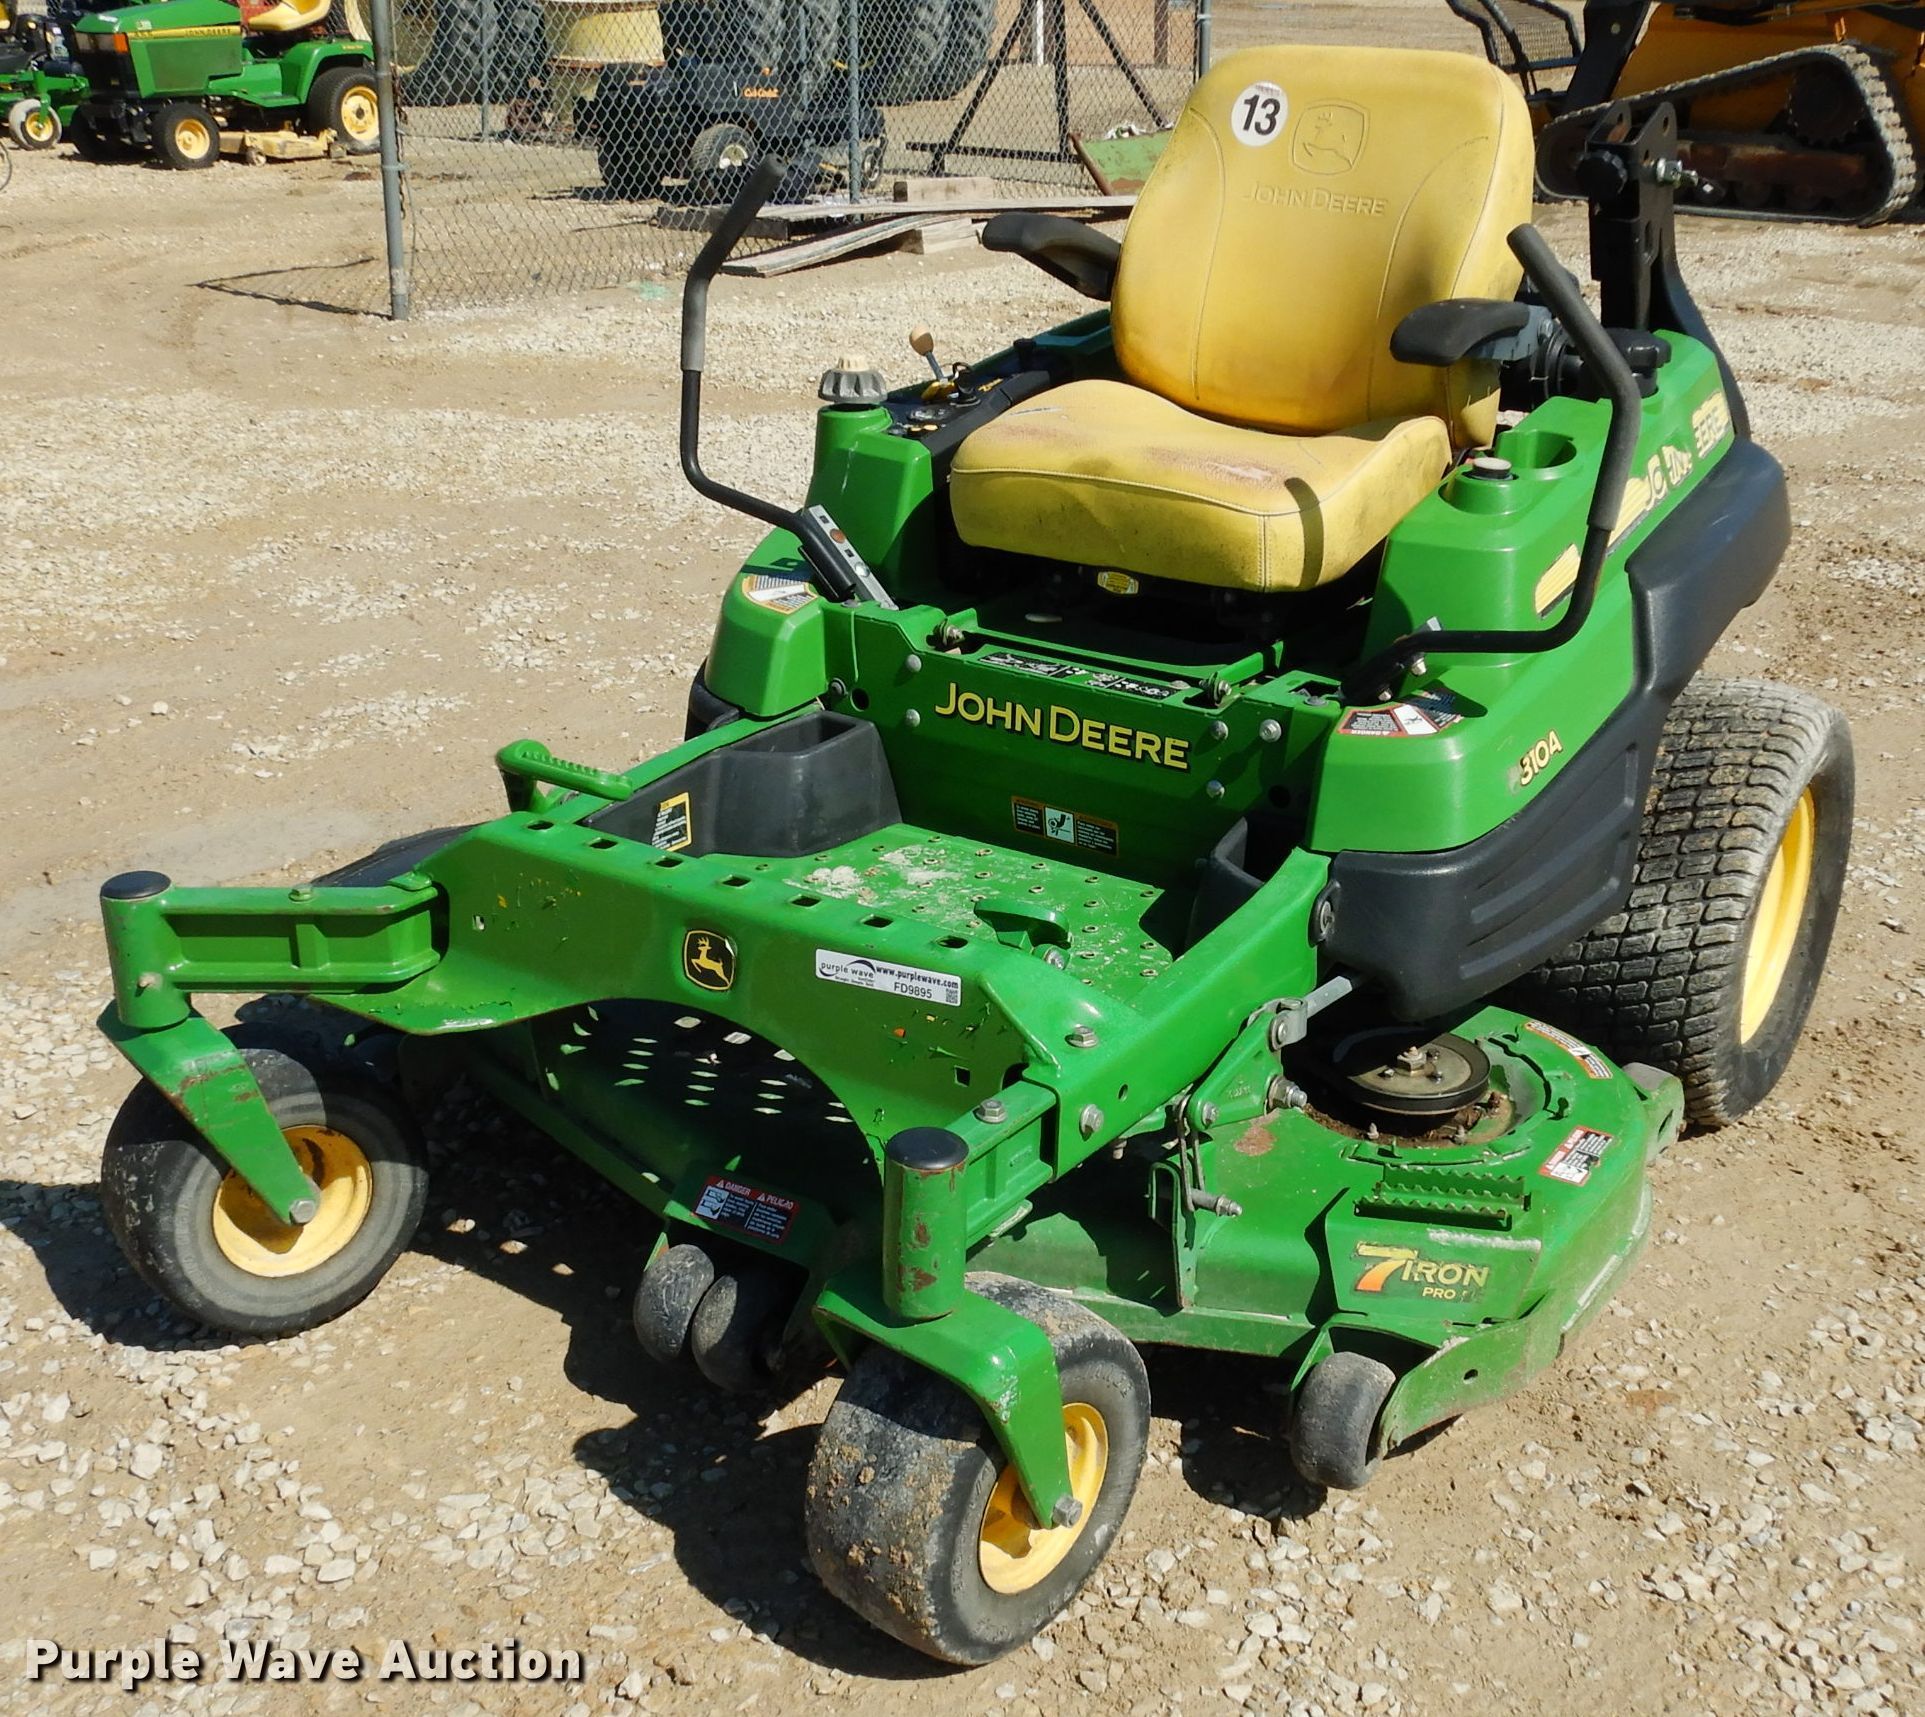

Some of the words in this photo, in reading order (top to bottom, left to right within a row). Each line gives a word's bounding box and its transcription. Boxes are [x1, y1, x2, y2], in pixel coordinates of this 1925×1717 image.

[1243, 94, 1281, 136] 13
[1245, 181, 1308, 208] JOHN
[1311, 187, 1389, 216] DEERE
[935, 682, 1042, 737] JOHN
[1049, 704, 1190, 771] DEERE
[820, 960, 848, 974] purple
[850, 968, 875, 979] wave
[876, 965, 959, 990] www.purplewave.com
[893, 982, 933, 999] FD9895
[1422, 1286, 1457, 1300] PRO
